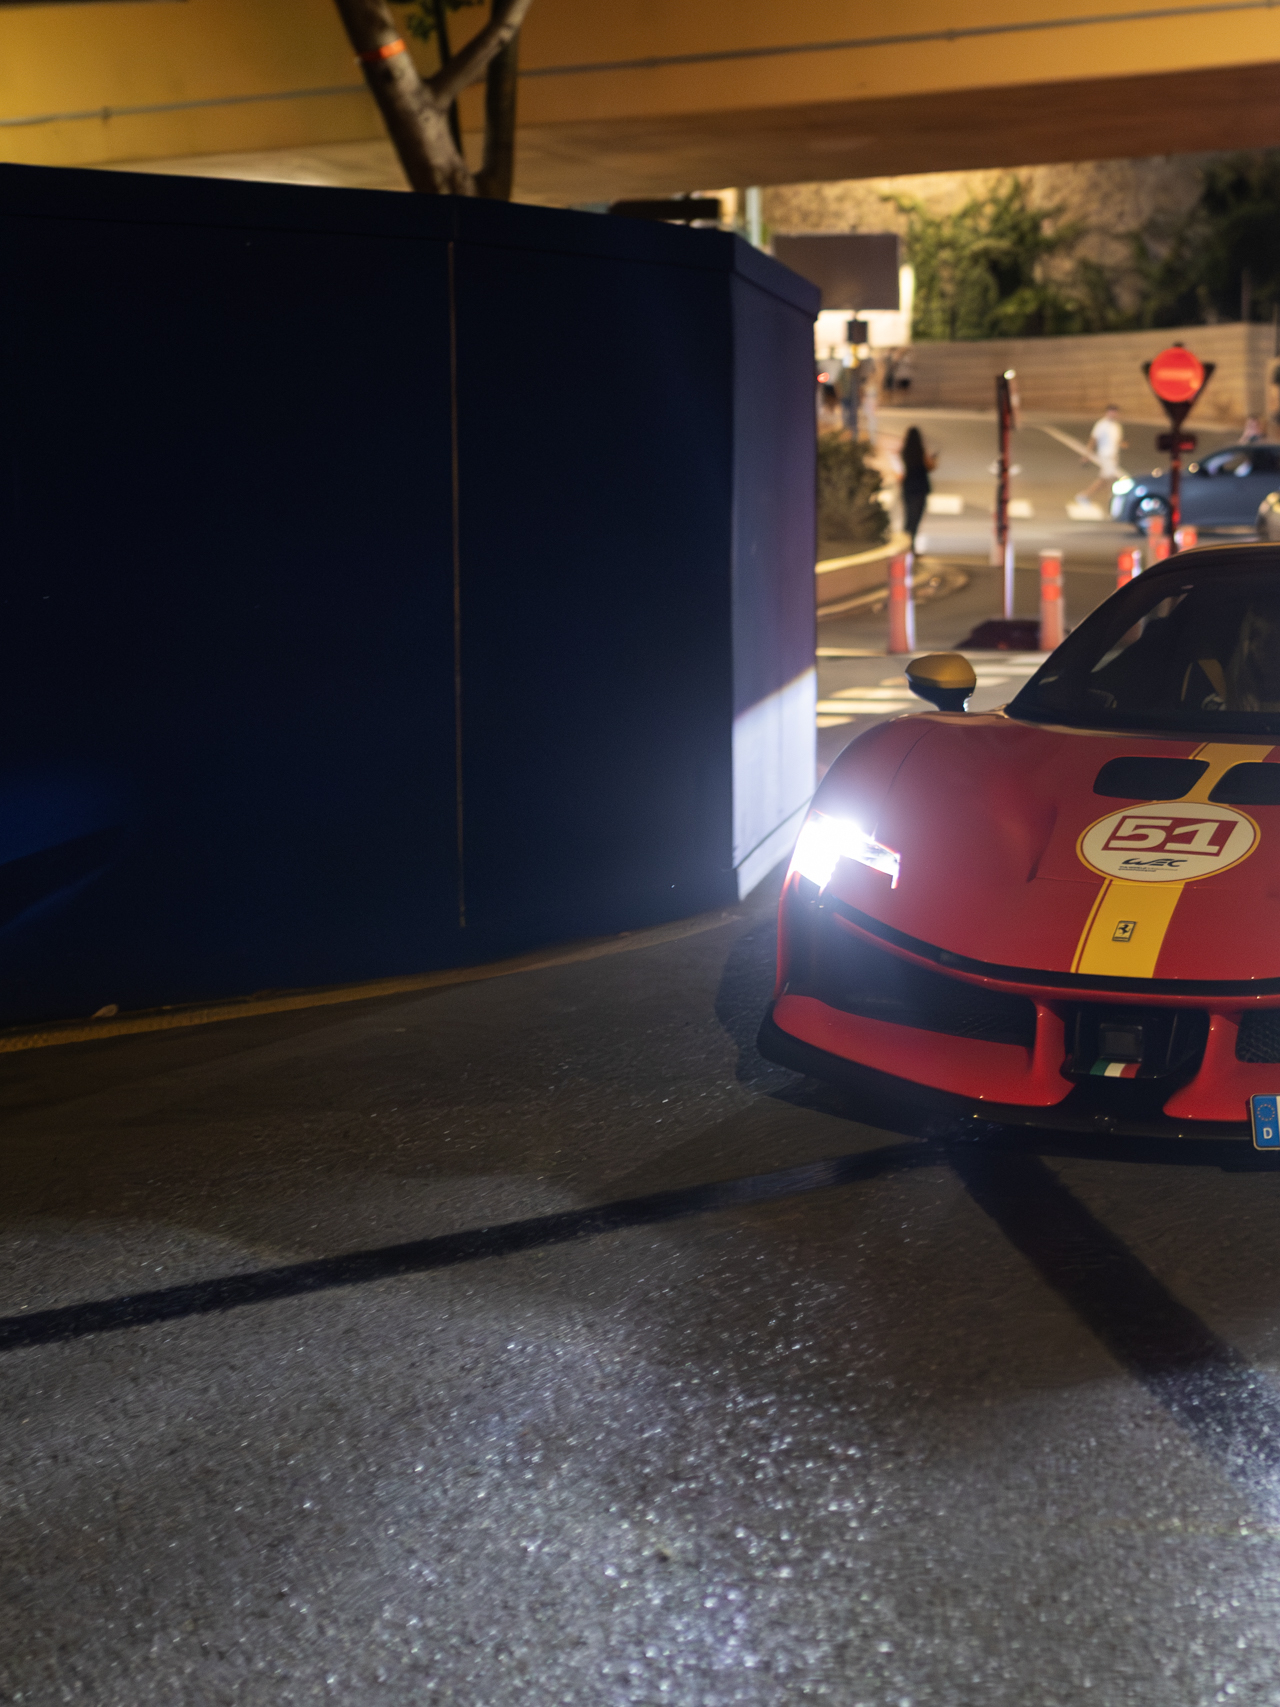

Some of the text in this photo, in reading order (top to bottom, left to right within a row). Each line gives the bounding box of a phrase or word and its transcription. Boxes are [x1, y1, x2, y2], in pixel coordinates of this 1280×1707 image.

[1108, 818, 1221, 854] 51
[1121, 857, 1188, 868] WEC
[1263, 1127, 1273, 1139] D
